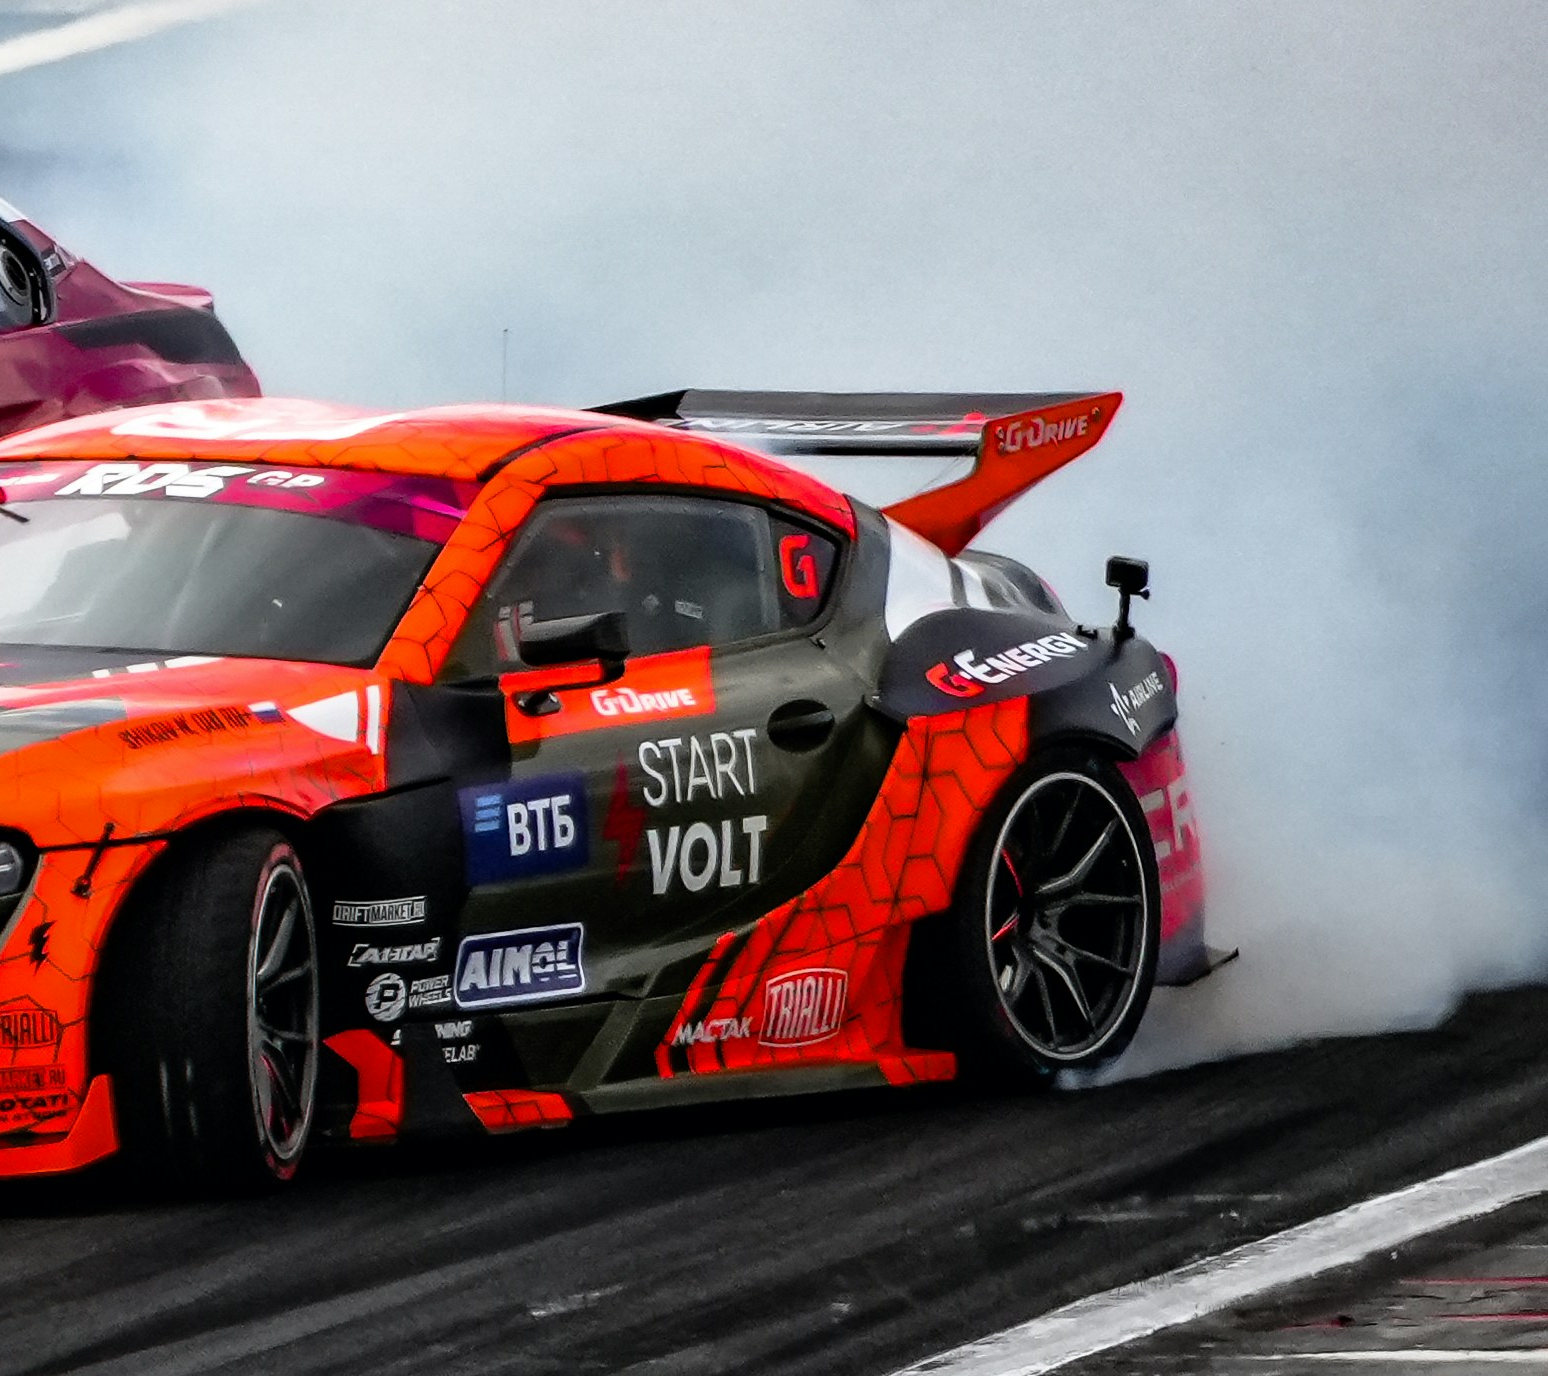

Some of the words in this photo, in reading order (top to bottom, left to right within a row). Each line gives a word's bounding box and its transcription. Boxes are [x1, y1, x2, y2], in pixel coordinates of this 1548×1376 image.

[56, 463, 258, 498] RDS
[245, 471, 326, 491] GP
[638, 728, 758, 808] START
[506, 794, 575, 857] ВТБ
[646, 814, 768, 895] VOLT
[410, 975, 450, 995] POWER
[459, 940, 577, 992] AIMOL
[766, 976, 843, 1041] TRIALLI
